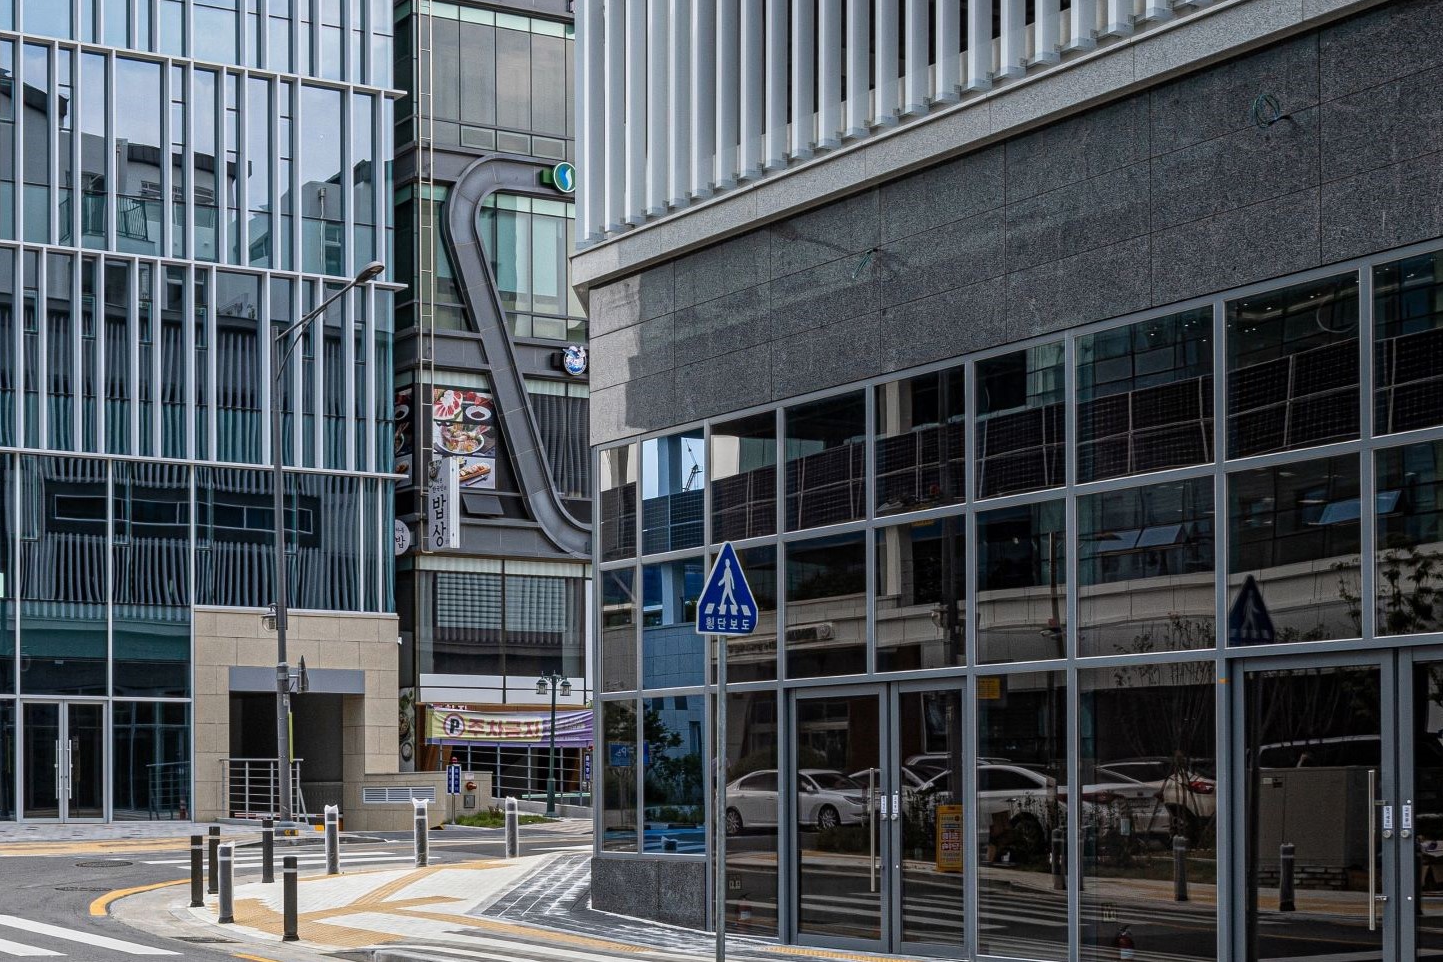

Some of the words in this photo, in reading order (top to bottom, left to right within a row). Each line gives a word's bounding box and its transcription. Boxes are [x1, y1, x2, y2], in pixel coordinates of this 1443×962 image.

[432, 494, 447, 548] 밥상
[705, 616, 751, 630] 횡단보도
[449, 718, 460, 734] P
[467, 718, 541, 736] 주차금지
